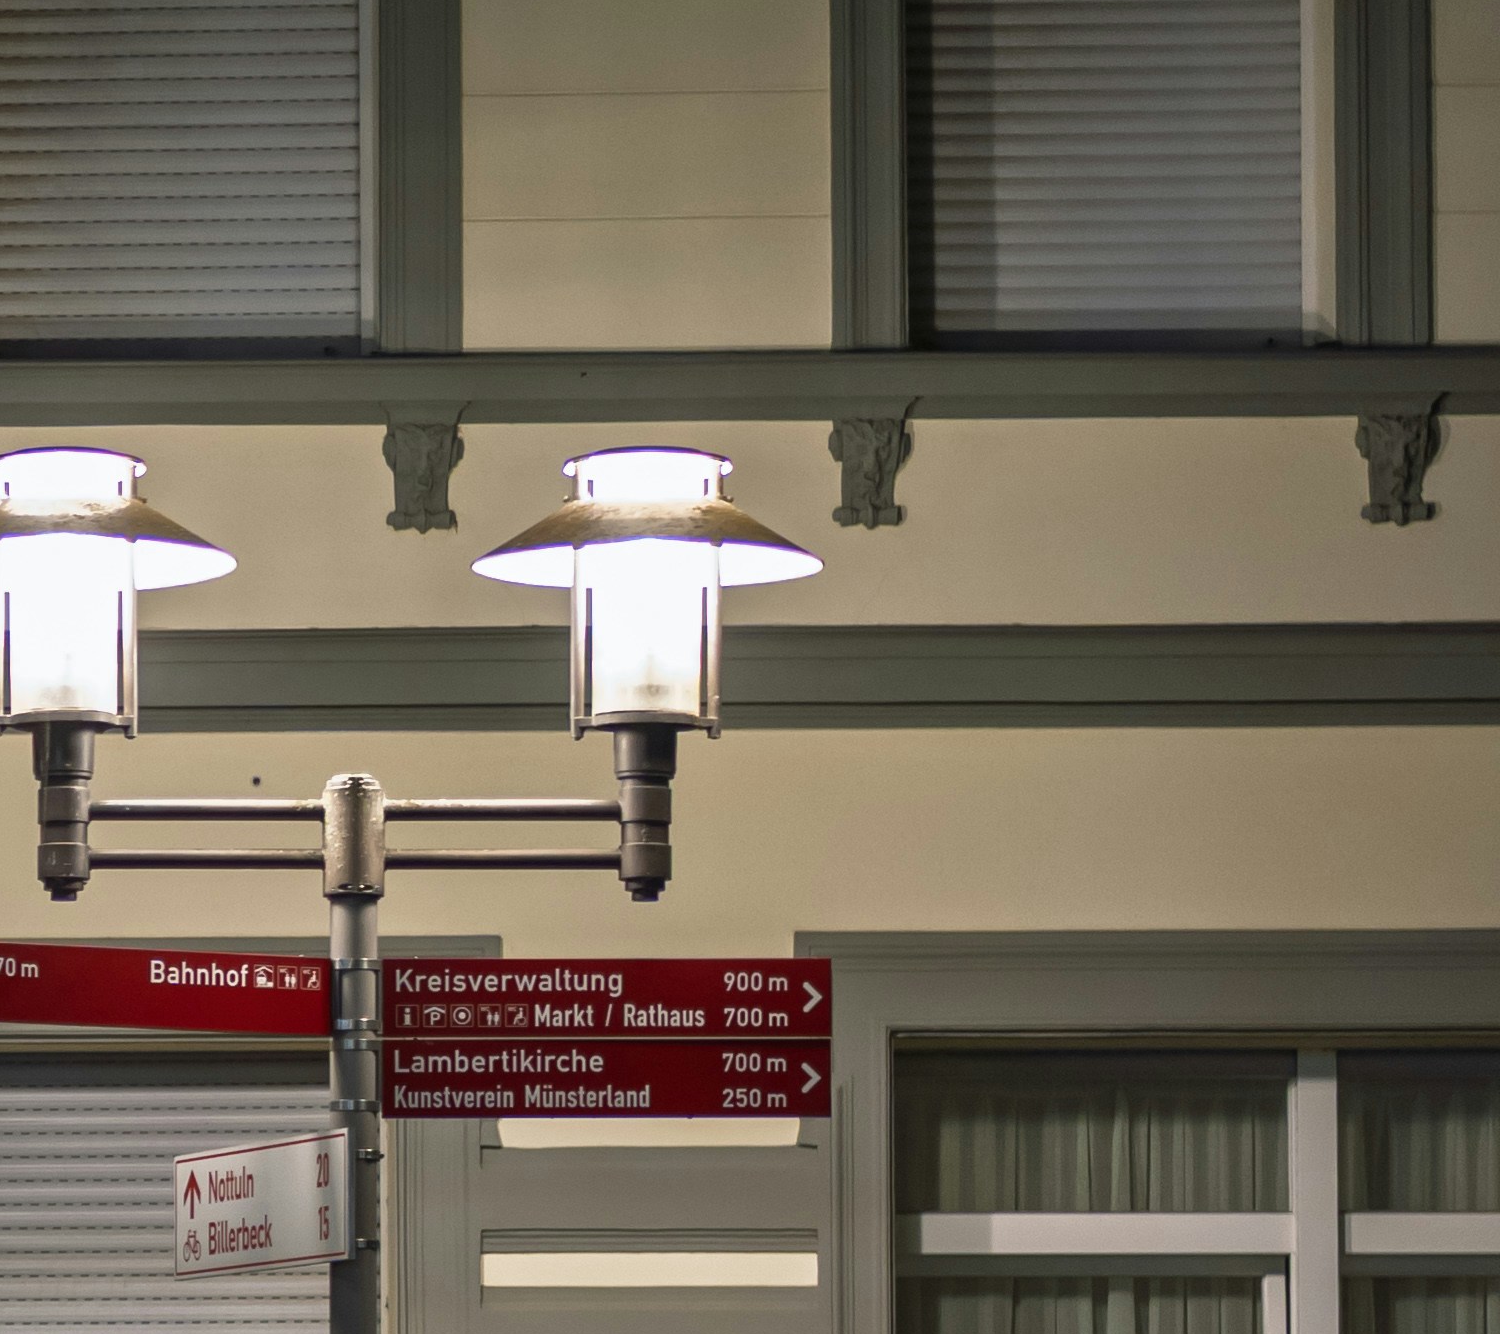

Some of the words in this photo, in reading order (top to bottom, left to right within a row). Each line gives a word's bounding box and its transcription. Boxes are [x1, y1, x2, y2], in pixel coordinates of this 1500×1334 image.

[21, 963, 39, 977] m
[150, 959, 249, 987] Bahnhof
[395, 968, 623, 997] Kreisverwaltung
[723, 972, 763, 992] 900
[768, 976, 789, 991] m
[534, 1004, 595, 1027] Markt
[604, 1004, 614, 1027] /
[623, 1003, 705, 1027] Rathaus
[723, 1008, 763, 1027] 700
[768, 1012, 789, 1027] m
[394, 1049, 604, 1073] Lambertikirche
[722, 1053, 761, 1072] 700
[766, 1057, 787, 1072] m
[394, 1085, 514, 1109] Kunstverein
[525, 1084, 651, 1109] Münsterland
[722, 1088, 761, 1108] 250
[767, 1092, 787, 1108] m
[208, 1166, 254, 1204] Nottuln
[316, 1152, 330, 1188] 20
[208, 1214, 273, 1255] Billerbeck
[318, 1205, 330, 1241] 15
